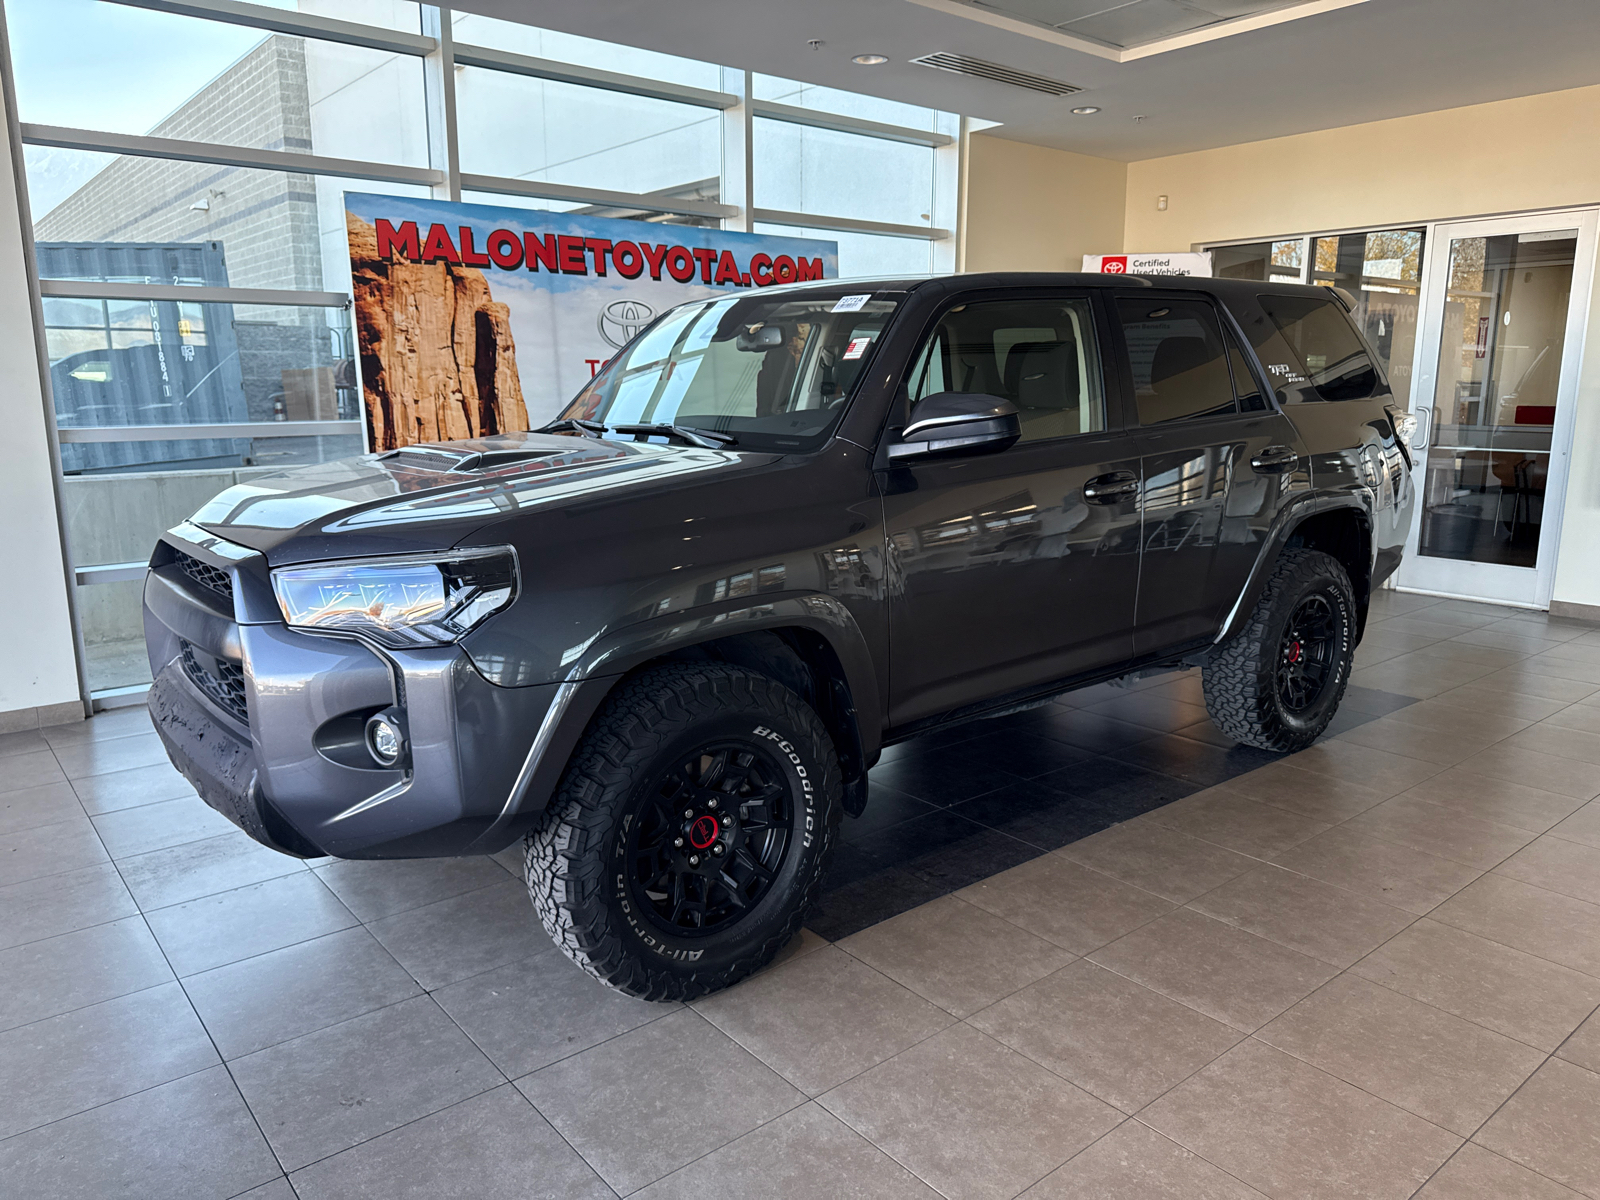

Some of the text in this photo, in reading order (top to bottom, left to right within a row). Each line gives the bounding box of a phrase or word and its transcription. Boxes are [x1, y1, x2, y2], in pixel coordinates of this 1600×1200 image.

[374, 218, 824, 287] MALONETOYOTA.COM
[1132, 259, 1170, 267] Certified
[1156, 268, 1191, 276] Vehicles
[1268, 364, 1290, 376] TRD
[752, 725, 816, 848] BFGoodrich
[615, 814, 704, 962] All-Terrain T/A
